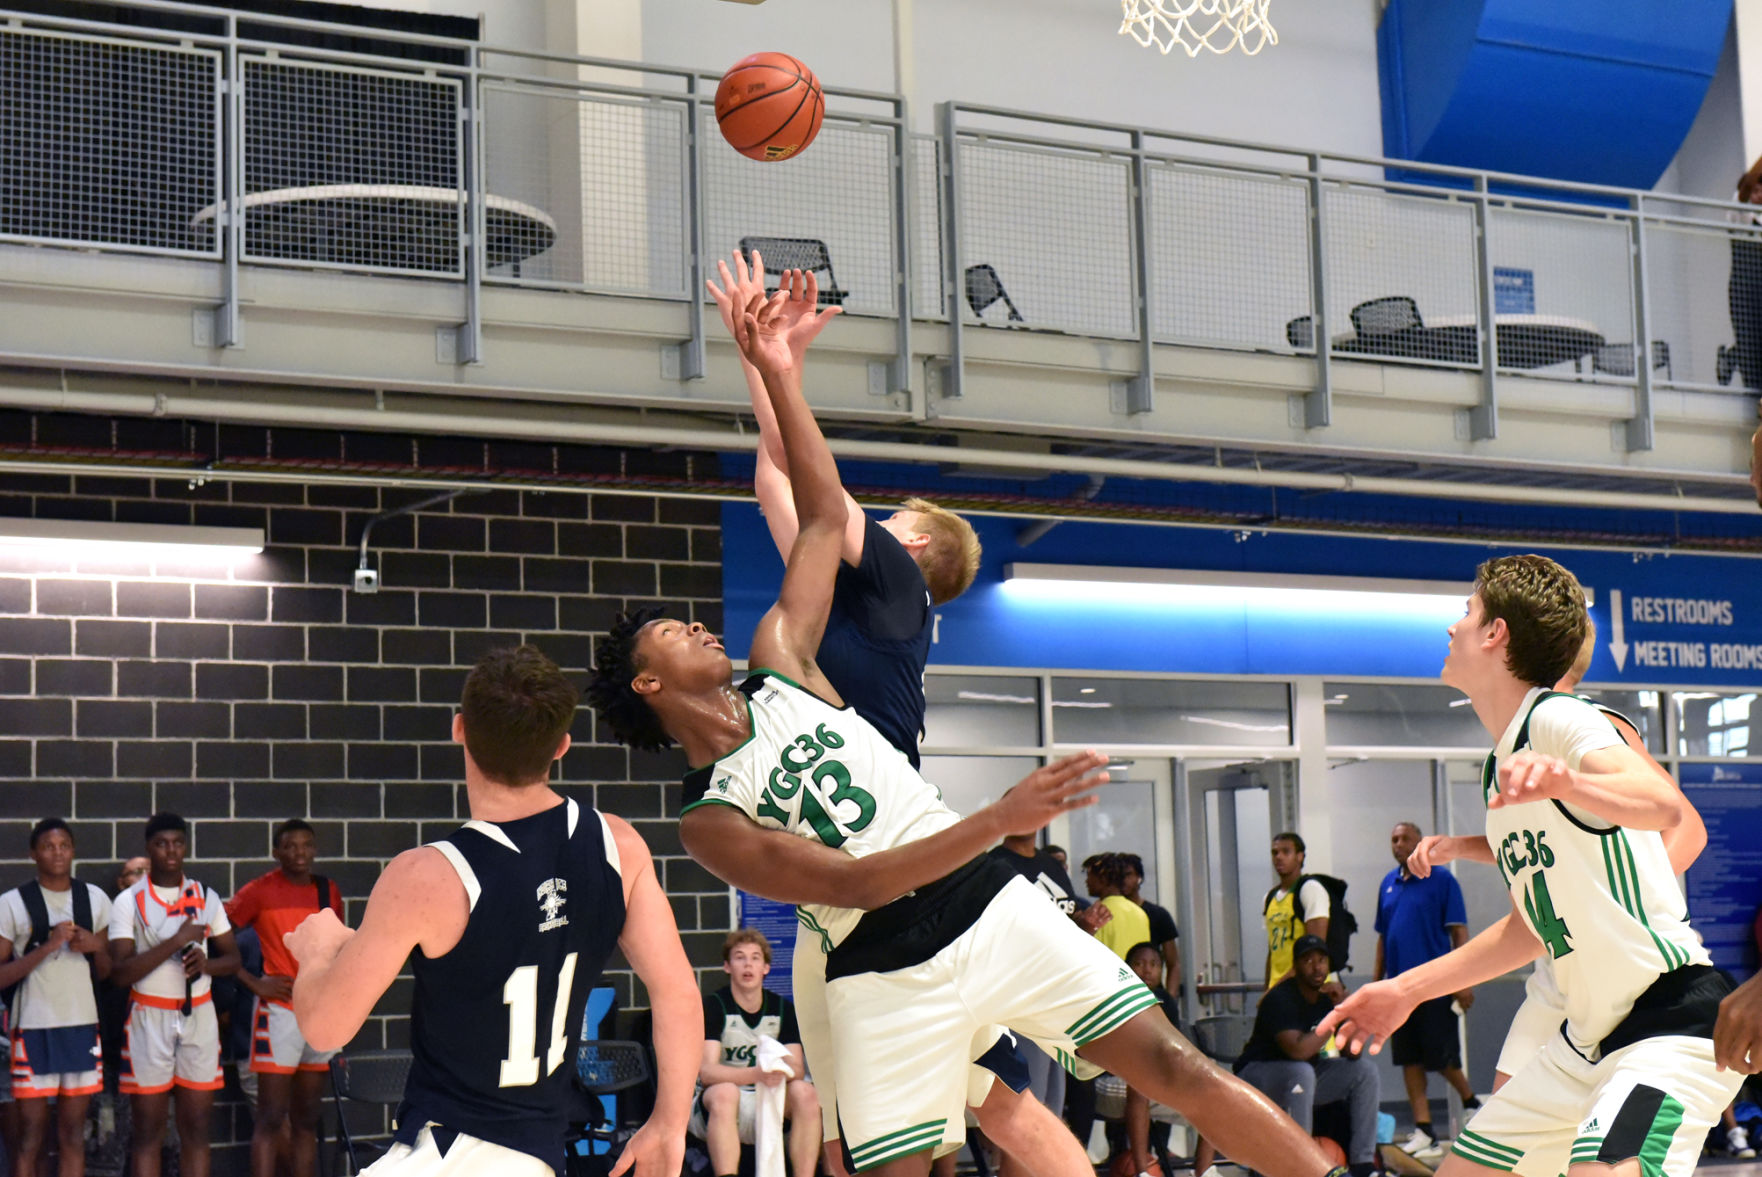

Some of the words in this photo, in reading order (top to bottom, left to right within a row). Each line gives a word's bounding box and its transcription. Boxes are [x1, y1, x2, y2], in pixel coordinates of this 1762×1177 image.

[1632, 597, 1733, 626] RESTROOMS
[1634, 641, 1706, 668] MEETING
[757, 722, 845, 827] YGC36
[798, 760, 877, 849] 13
[499, 951, 578, 1088] 11
